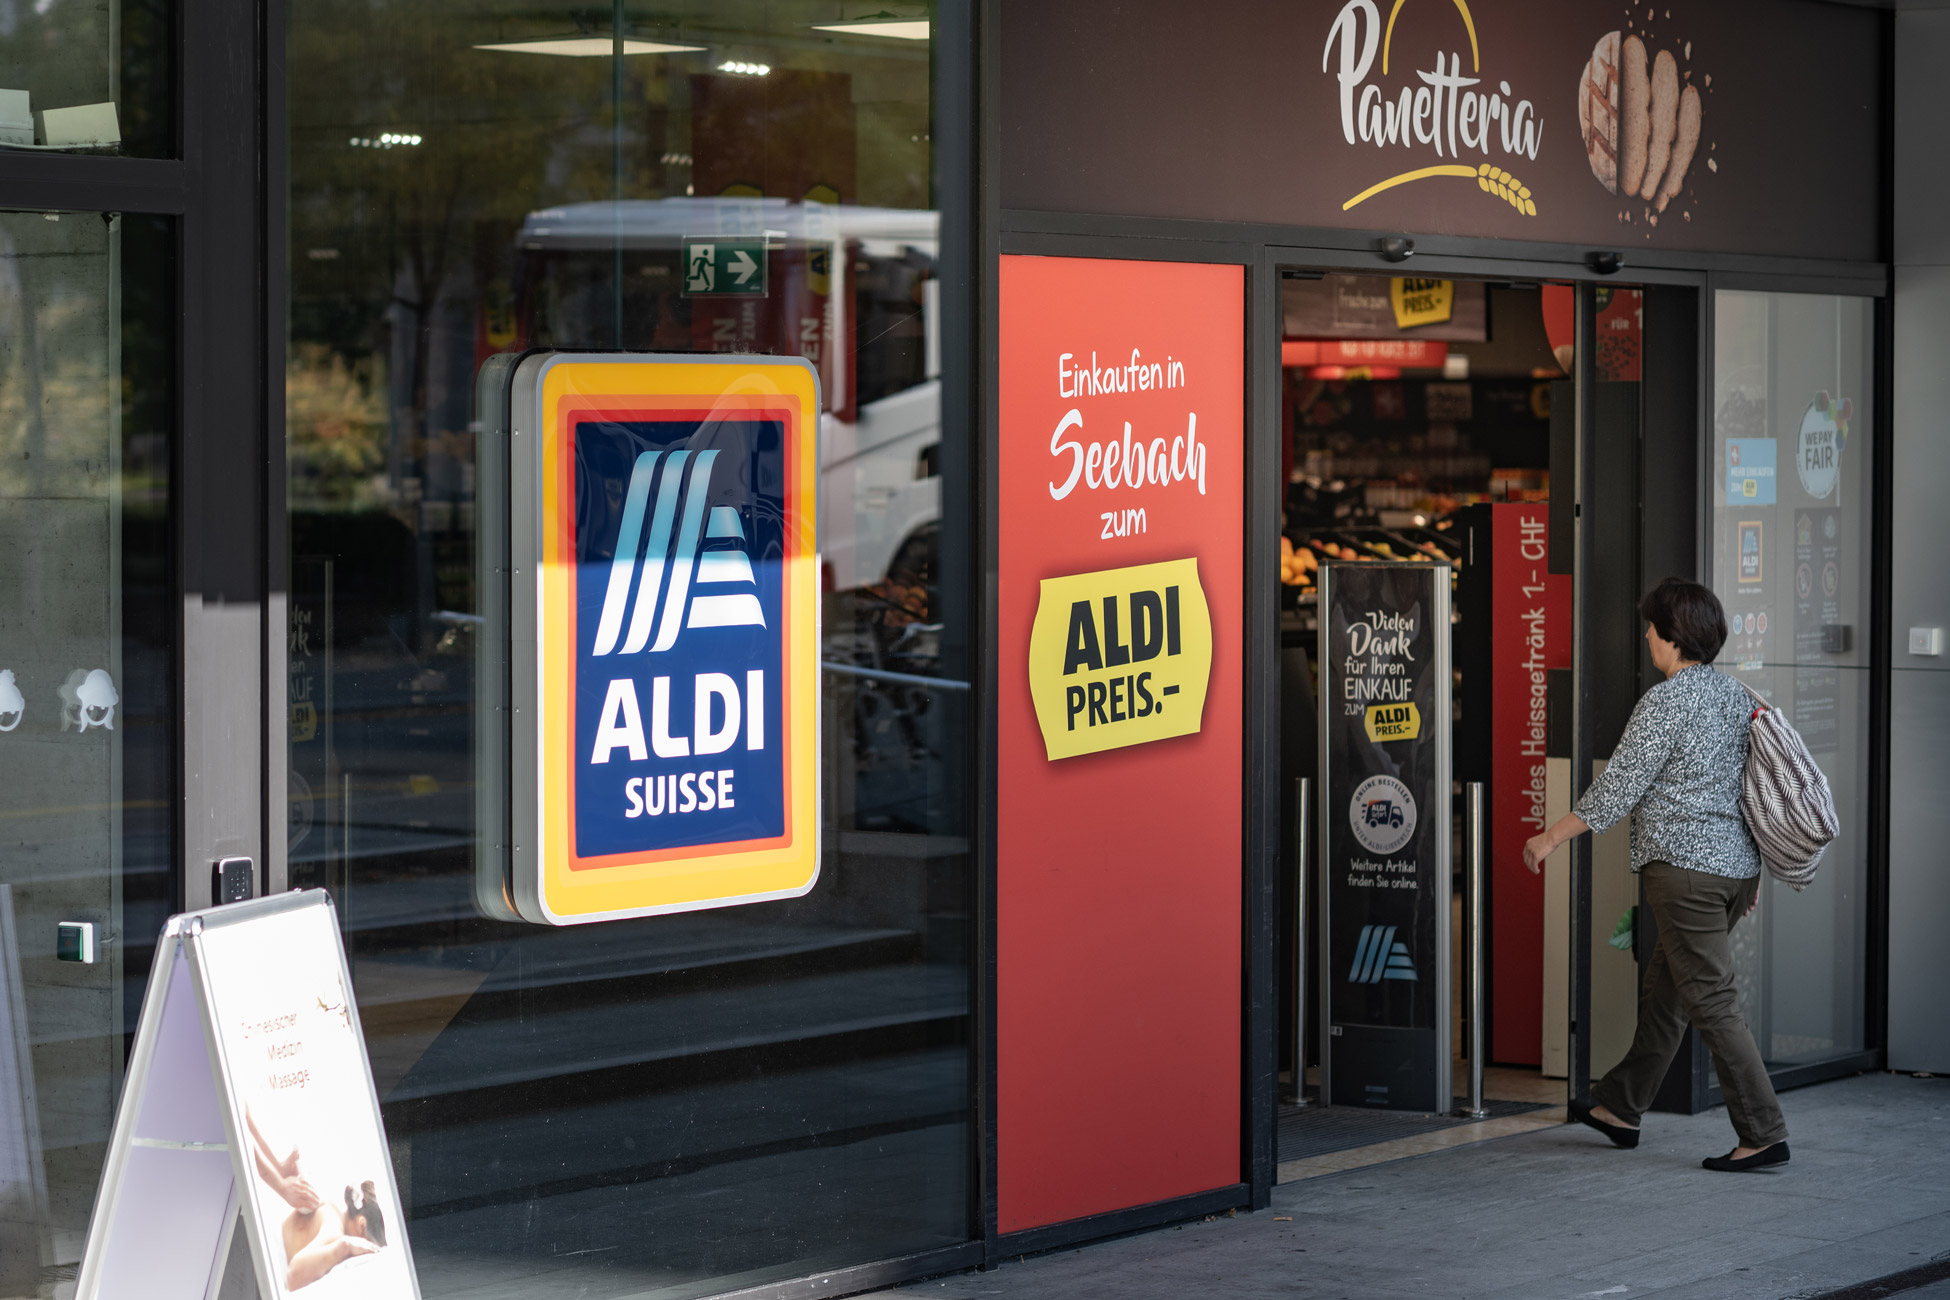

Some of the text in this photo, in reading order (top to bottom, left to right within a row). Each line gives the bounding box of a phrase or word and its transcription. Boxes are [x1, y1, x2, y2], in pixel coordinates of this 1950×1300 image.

[1322, 0, 1543, 160] Panetteria
[1059, 348, 1185, 398] Einkaufen in
[1049, 408, 1206, 501] Seebach
[1805, 446, 1834, 471] FAIR
[1100, 507, 1147, 540] zum
[1520, 516, 1546, 560] CHF
[1742, 555, 1759, 567] ALDI
[1063, 585, 1181, 676] ALDI
[1365, 609, 1414, 632] Vielen
[1346, 621, 1415, 662] Dank
[1344, 656, 1405, 675] für Ihren
[1344, 677, 1412, 701] EINKAUF
[1520, 607, 1547, 756] Heissgetränk
[590, 669, 765, 765] ALDI
[1344, 703, 1364, 716] ZUM
[1374, 707, 1411, 725] ALDI
[625, 769, 735, 818] SUISSE
[1355, 779, 1411, 804] ONLINE BESTELLEN
[1520, 764, 1546, 830] Jedes
[1371, 803, 1387, 811] ALDI
[1350, 858, 1416, 873] Weitere Artikel
[1347, 873, 1375, 887] finden
[1376, 874, 1389, 888] Sie
